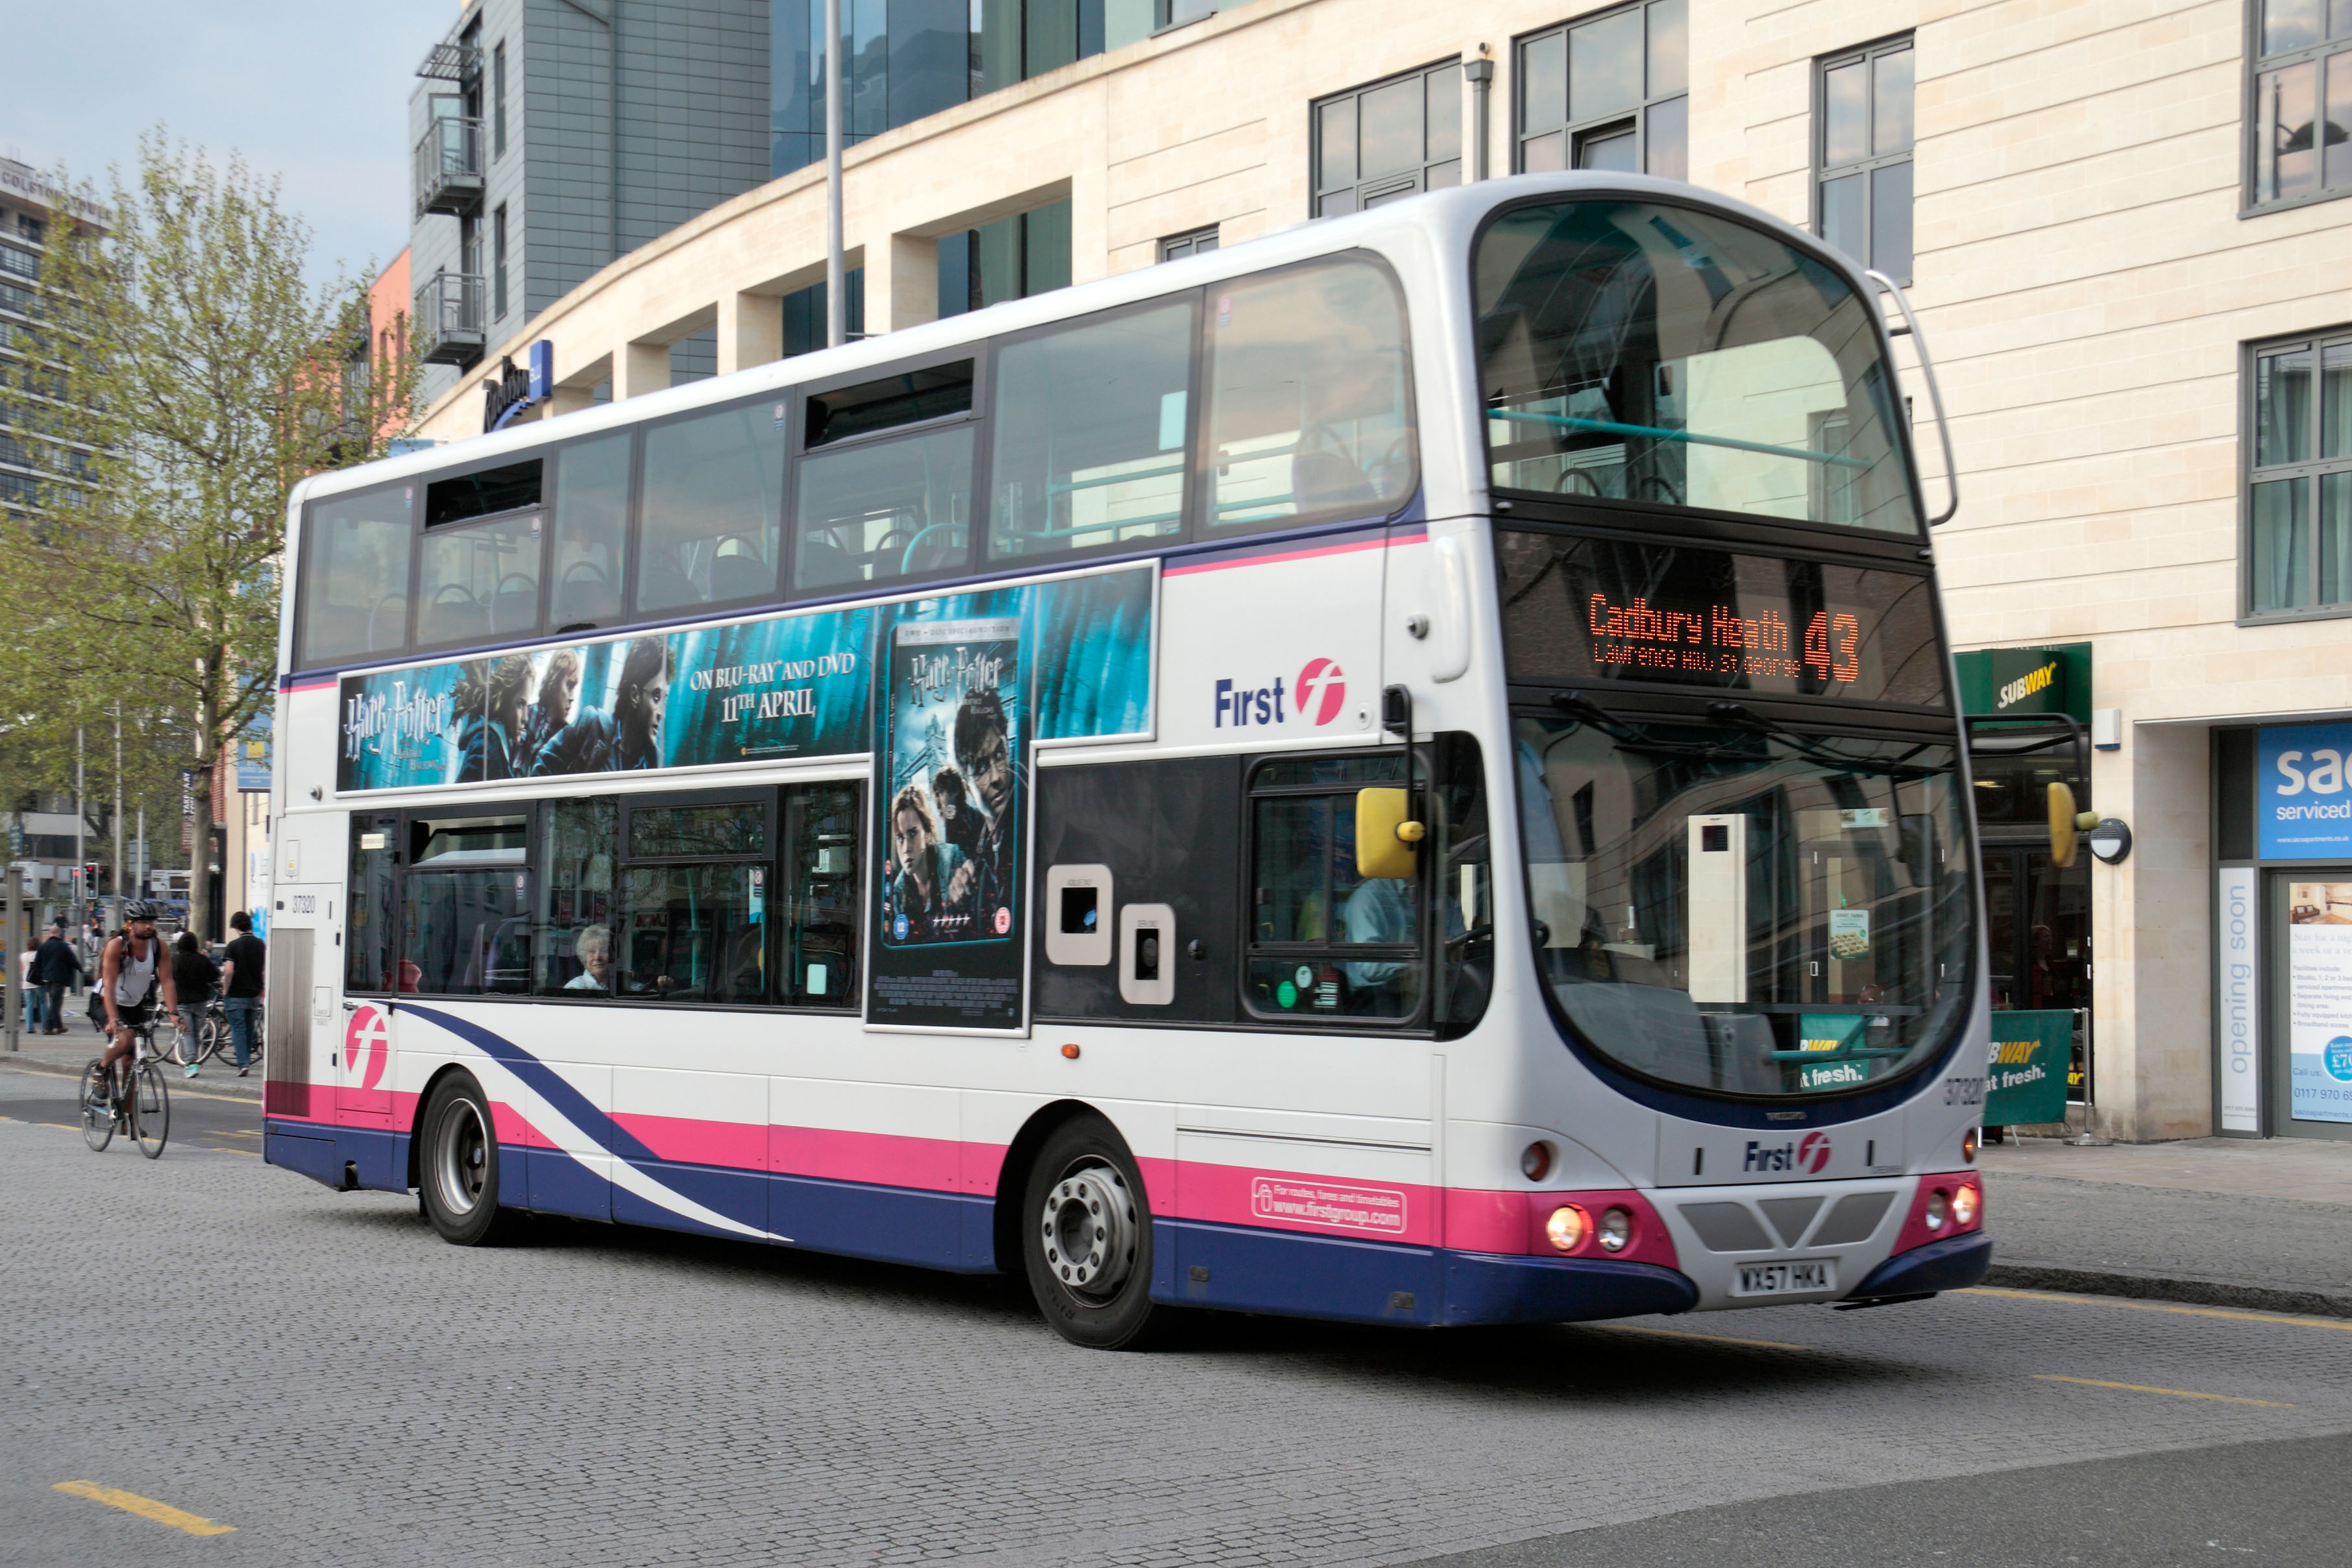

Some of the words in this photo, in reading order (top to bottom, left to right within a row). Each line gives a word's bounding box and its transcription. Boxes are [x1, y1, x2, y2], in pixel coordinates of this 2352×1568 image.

[1591, 593, 1702, 644] Cadbury
[1713, 605, 1787, 651] Heath
[1805, 611, 1858, 682] 43
[690, 670, 713, 691] ON
[781, 660, 815, 681] AND
[818, 652, 855, 678] DVD
[1594, 643, 1676, 668] Lawrence
[1721, 654, 1738, 673] St
[907, 653, 955, 707] Harry
[955, 646, 1003, 708] Potter
[1998, 661, 2056, 709] SUBWAY
[722, 692, 755, 722] 11TH
[757, 688, 816, 719] APRIL
[1214, 676, 1284, 728] First
[343, 691, 393, 763] Harry
[393, 681, 445, 755] Potter
[2277, 749, 2352, 796] sa
[2276, 800, 2351, 820] serviced
[293, 895, 315, 914] 37320
[2230, 885, 2246, 950] soon
[2225, 963, 2252, 1073] opening
[2002, 1064, 2046, 1088] fresh.
[2293, 1067, 2308, 1076] Call
[2294, 1087, 2317, 1099] 0117
[2320, 1089, 2340, 1100] 970
[1743, 1140, 1795, 1171] First
[1273, 1184, 1288, 1195] For
[1288, 1186, 1317, 1200] routes,
[1317, 1189, 1340, 1201] fares
[1340, 1193, 1355, 1203] and
[1356, 1194, 1401, 1208] timetables
[1272, 1200, 1401, 1226] www.firstgroup.com
[1739, 1266, 1787, 1292] WX57
[1792, 1264, 1829, 1290] HKA
